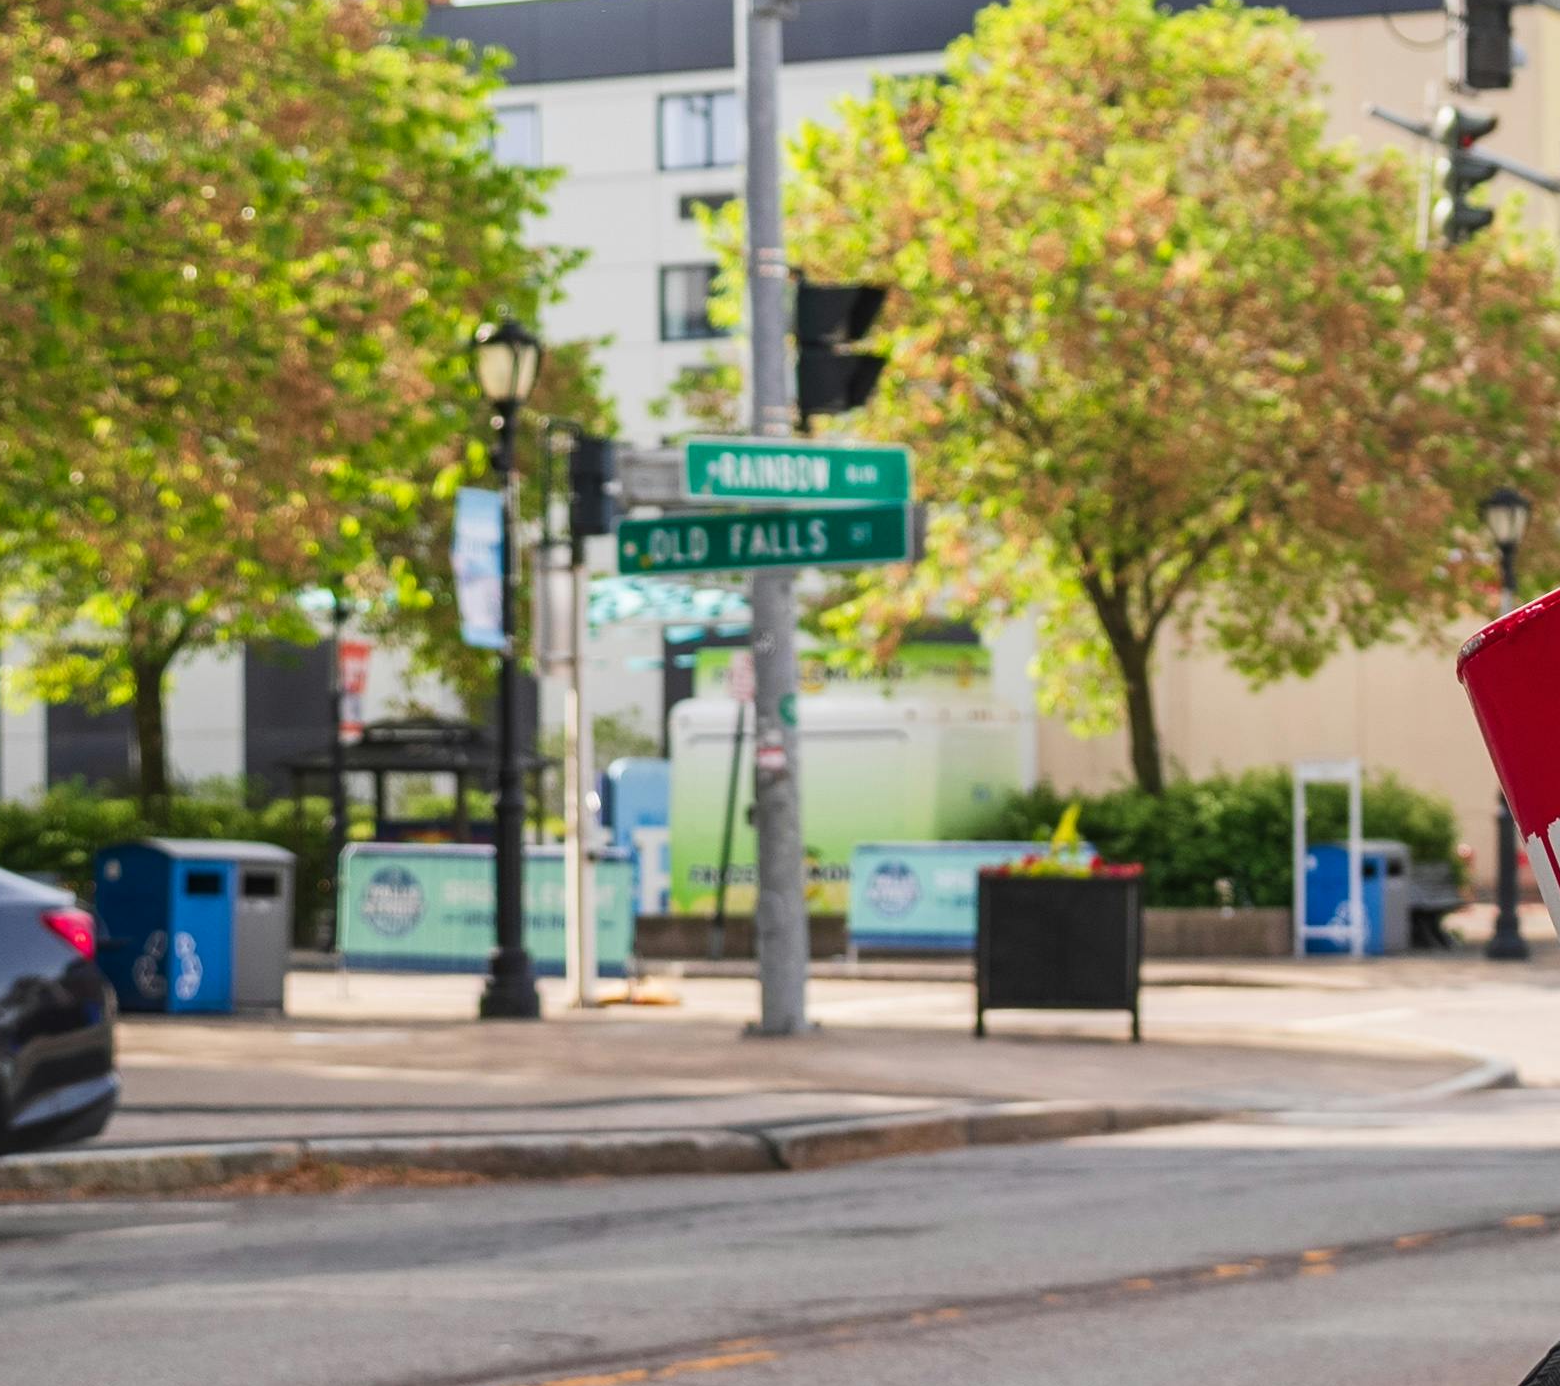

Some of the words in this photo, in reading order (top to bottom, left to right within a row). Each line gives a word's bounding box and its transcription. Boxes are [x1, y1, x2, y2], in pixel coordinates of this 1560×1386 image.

[719, 451, 831, 492] RAINBOW
[648, 526, 709, 563] OLD
[729, 518, 829, 558] FALLS
